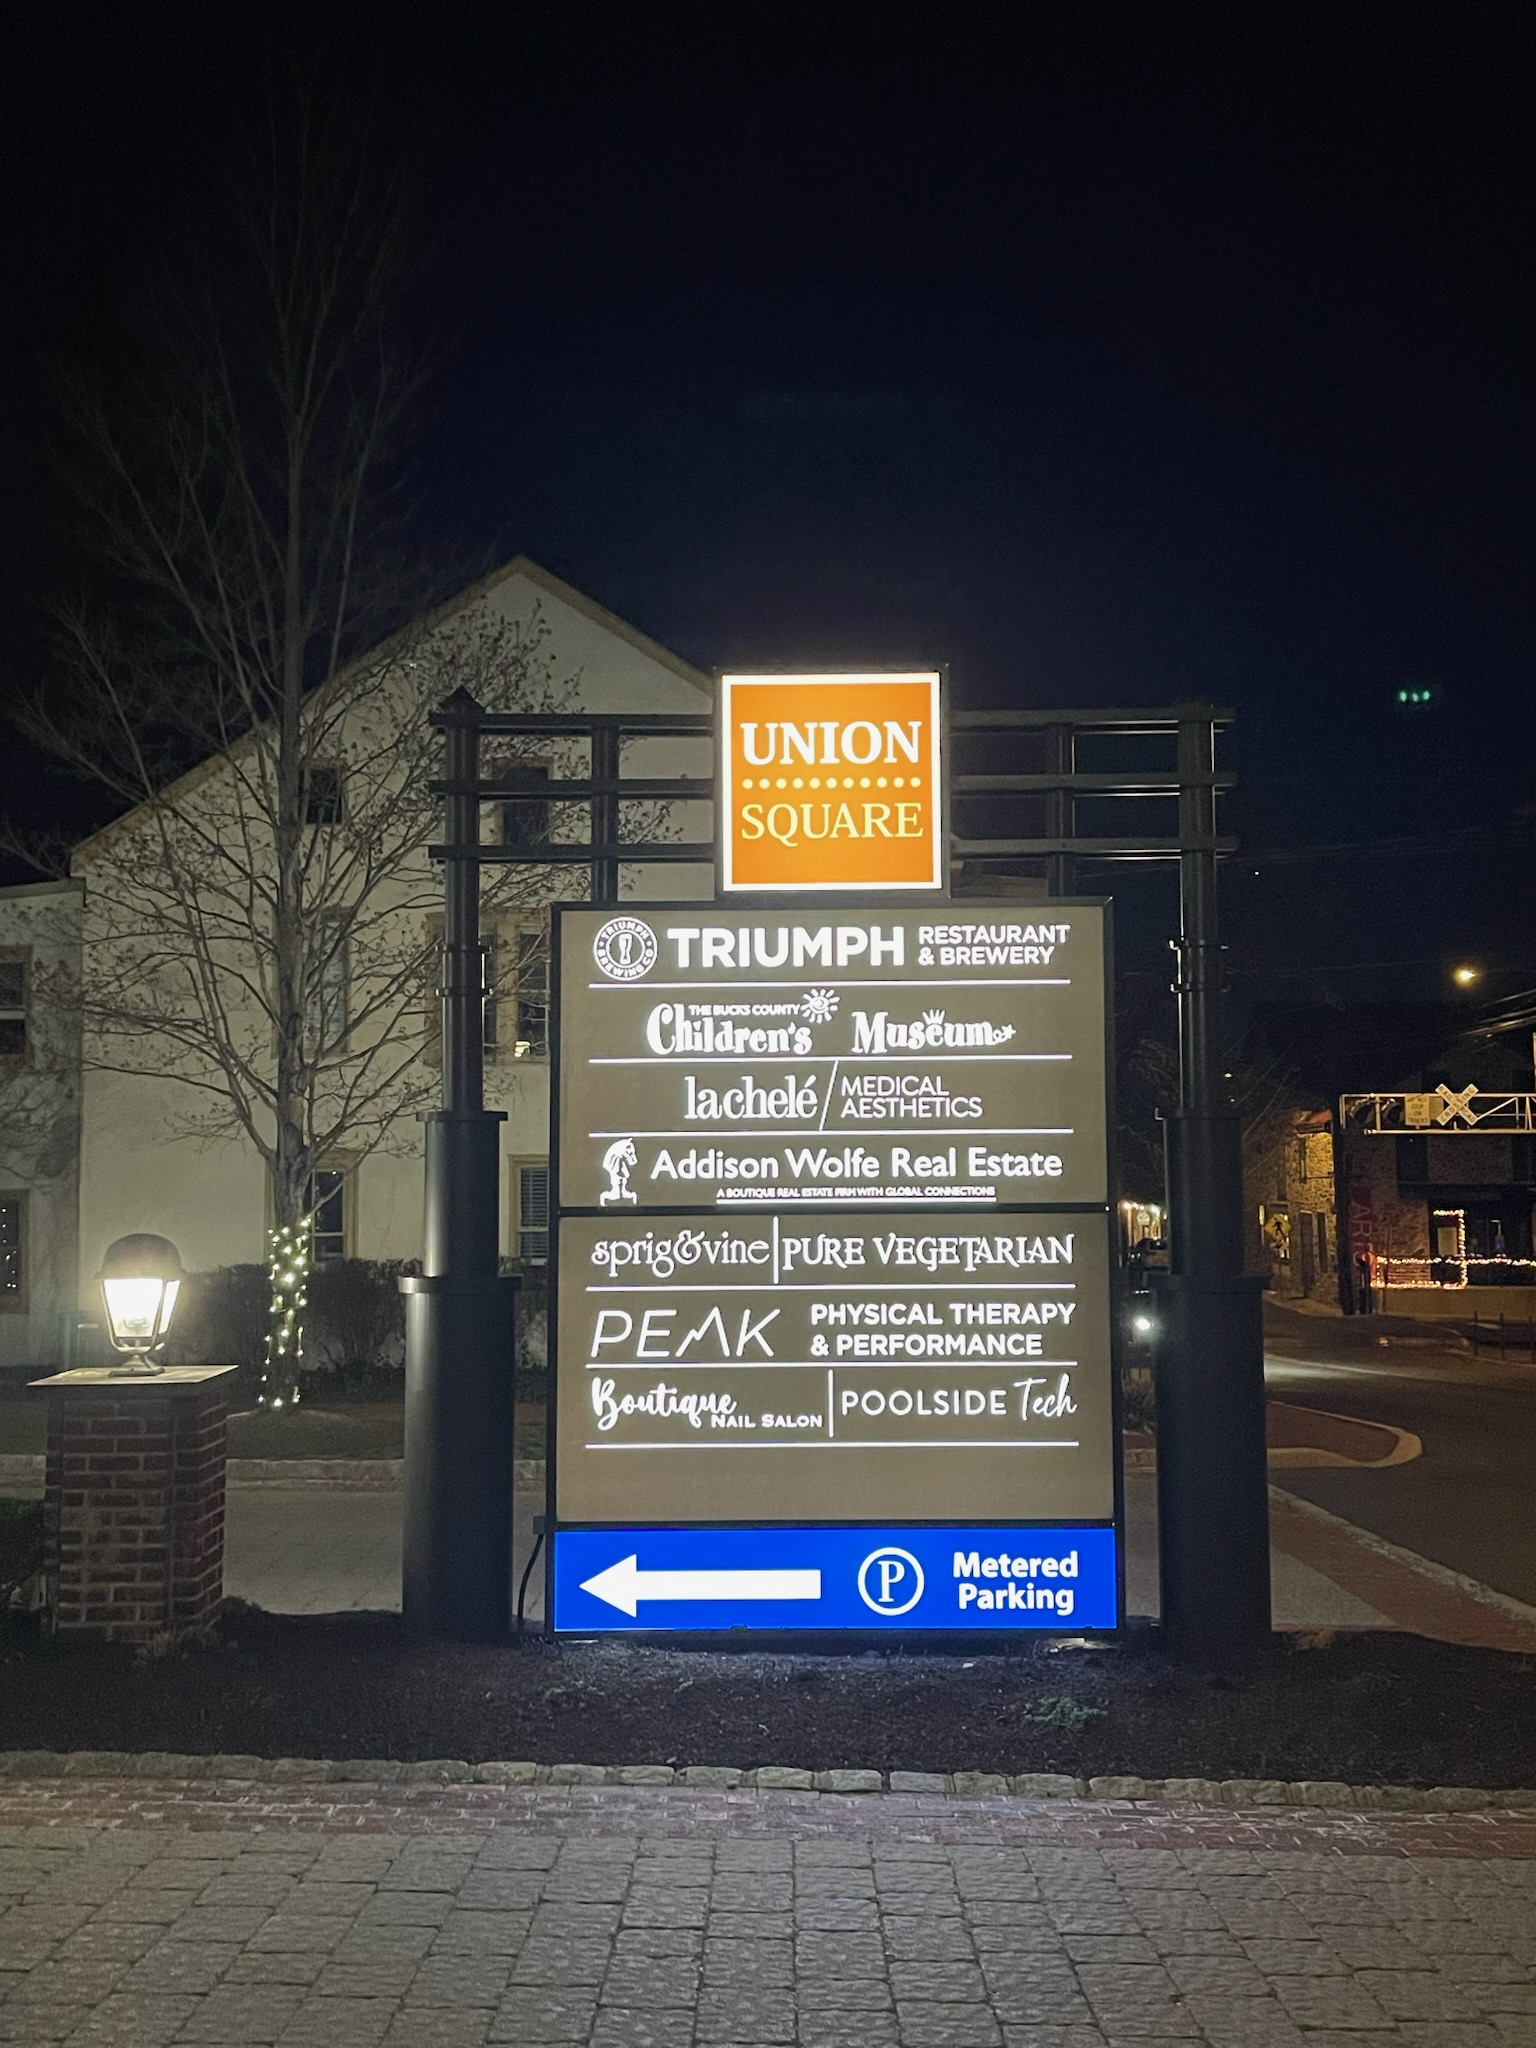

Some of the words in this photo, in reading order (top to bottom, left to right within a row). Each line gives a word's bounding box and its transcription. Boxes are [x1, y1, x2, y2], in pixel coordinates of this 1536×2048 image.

[740, 721, 922, 765] UNION
[741, 803, 923, 847] SQUARE
[601, 921, 649, 939] TRIUMPH
[918, 925, 1071, 944] RESTAURANT
[597, 948, 645, 977] BREWING
[667, 926, 905, 968] TRIUMPH
[918, 947, 935, 966] &
[940, 946, 1055, 965] BREWERY
[688, 1005, 712, 1016] THE
[713, 1005, 750, 1016] BUCKS
[752, 1004, 800, 1016] COUNTY
[646, 1003, 813, 1055] Children's
[851, 1010, 993, 1054] Museum
[684, 1075, 819, 1119] lachelé
[841, 1076, 950, 1097] MEDICAL
[841, 1097, 983, 1118] AESTHETICS
[650, 1149, 779, 1179] Addison
[784, 1148, 880, 1178] Wolfe
[891, 1147, 956, 1177] Real
[968, 1147, 1063, 1176] Estate
[717, 1188, 725, 1198] A
[726, 1188, 776, 1198] BOUTIQUE
[777, 1188, 800, 1198] REAL
[801, 1187, 834, 1197] ESTATE
[834, 1187, 857, 1197] FIRM
[857, 1187, 884, 1197] WITH
[885, 1187, 924, 1197] GLOBAL
[924, 1186, 996, 1197] CONNECTIONS
[591, 1230, 770, 1278] sprig&vine
[782, 1234, 865, 1270] PURE
[873, 1233, 1075, 1272] VEGETARIAN
[810, 1303, 943, 1326] PHYSICAL
[949, 1303, 1077, 1325] THERAPY
[590, 1306, 781, 1358] PEAK
[810, 1333, 830, 1357] &
[836, 1333, 1043, 1356] PERFORMANCE
[591, 1377, 738, 1431] Boutique
[841, 1390, 1007, 1416] POOLSIDE
[1014, 1373, 1078, 1421] Tech
[953, 1550, 1079, 1579] Metered
[877, 1560, 905, 1603] P
[958, 1582, 1075, 1617] Parking
